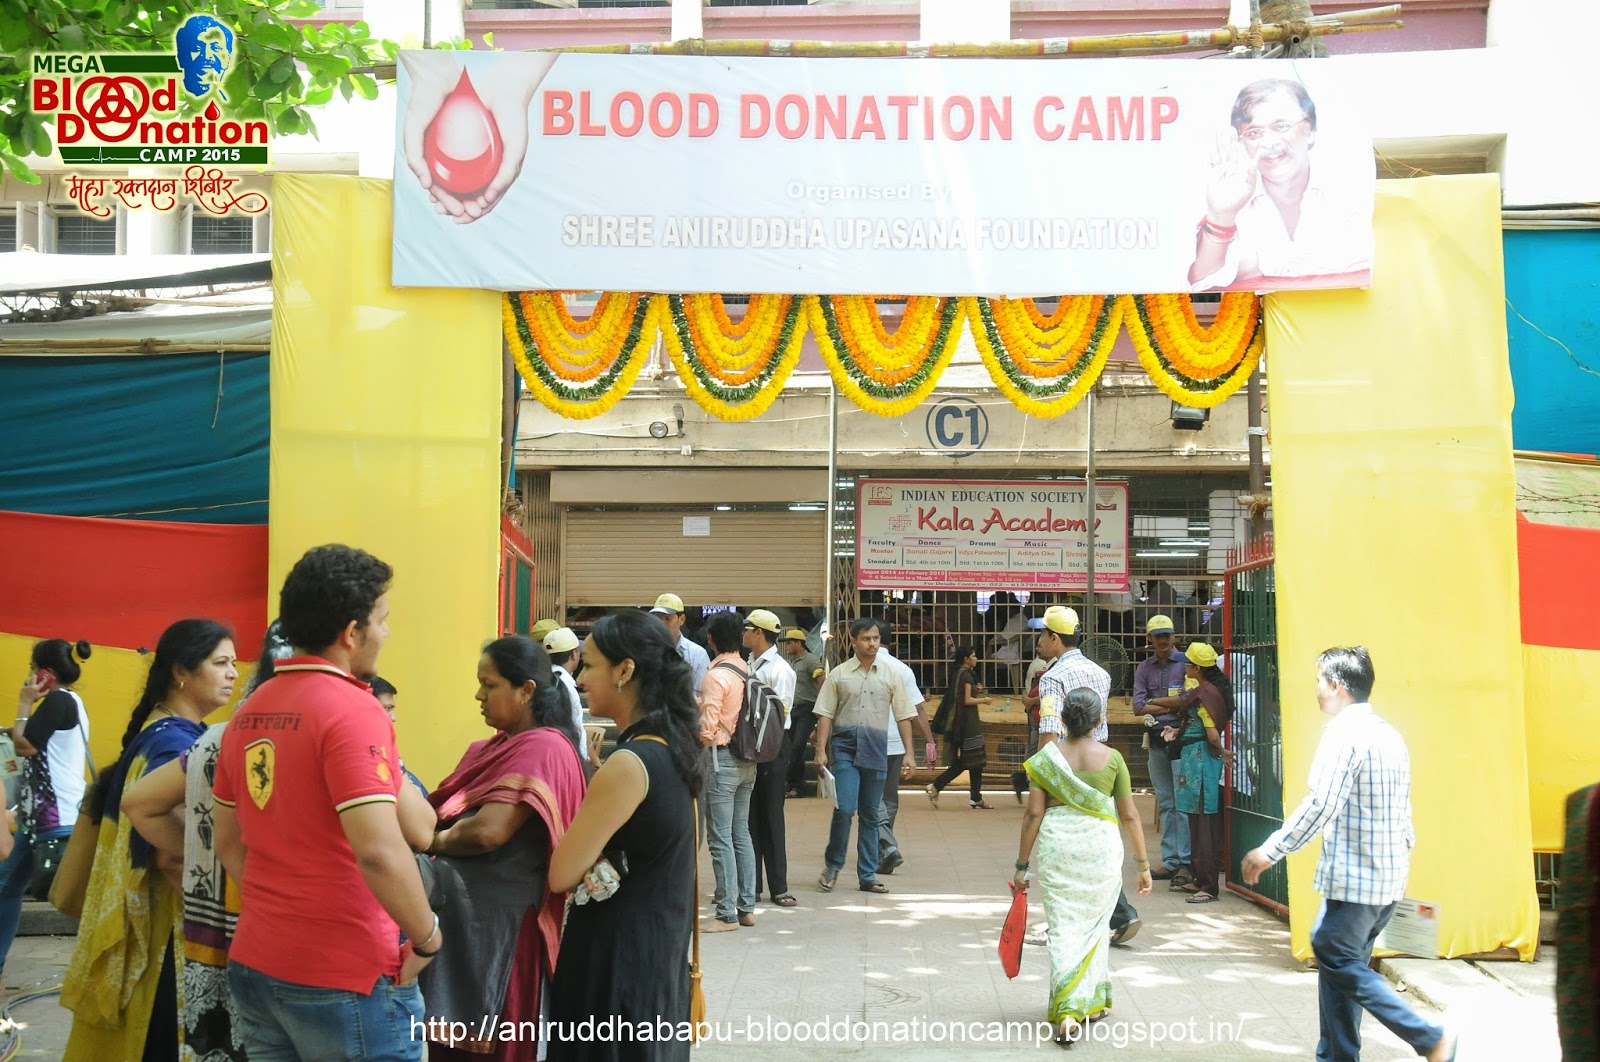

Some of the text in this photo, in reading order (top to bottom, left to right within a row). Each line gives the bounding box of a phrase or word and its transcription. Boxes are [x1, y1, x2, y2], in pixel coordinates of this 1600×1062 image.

[543, 90, 1180, 142] BLOOD DONATION CAMP
[787, 181, 912, 205] Organised
[562, 214, 1159, 250] SHREE ANIRUDDHA UPASANA FOUNDATION
[935, 405, 979, 447] C1
[901, 490, 1086, 503] INDIAN EDUCATION SOCIETY
[918, 506, 974, 532] Kala
